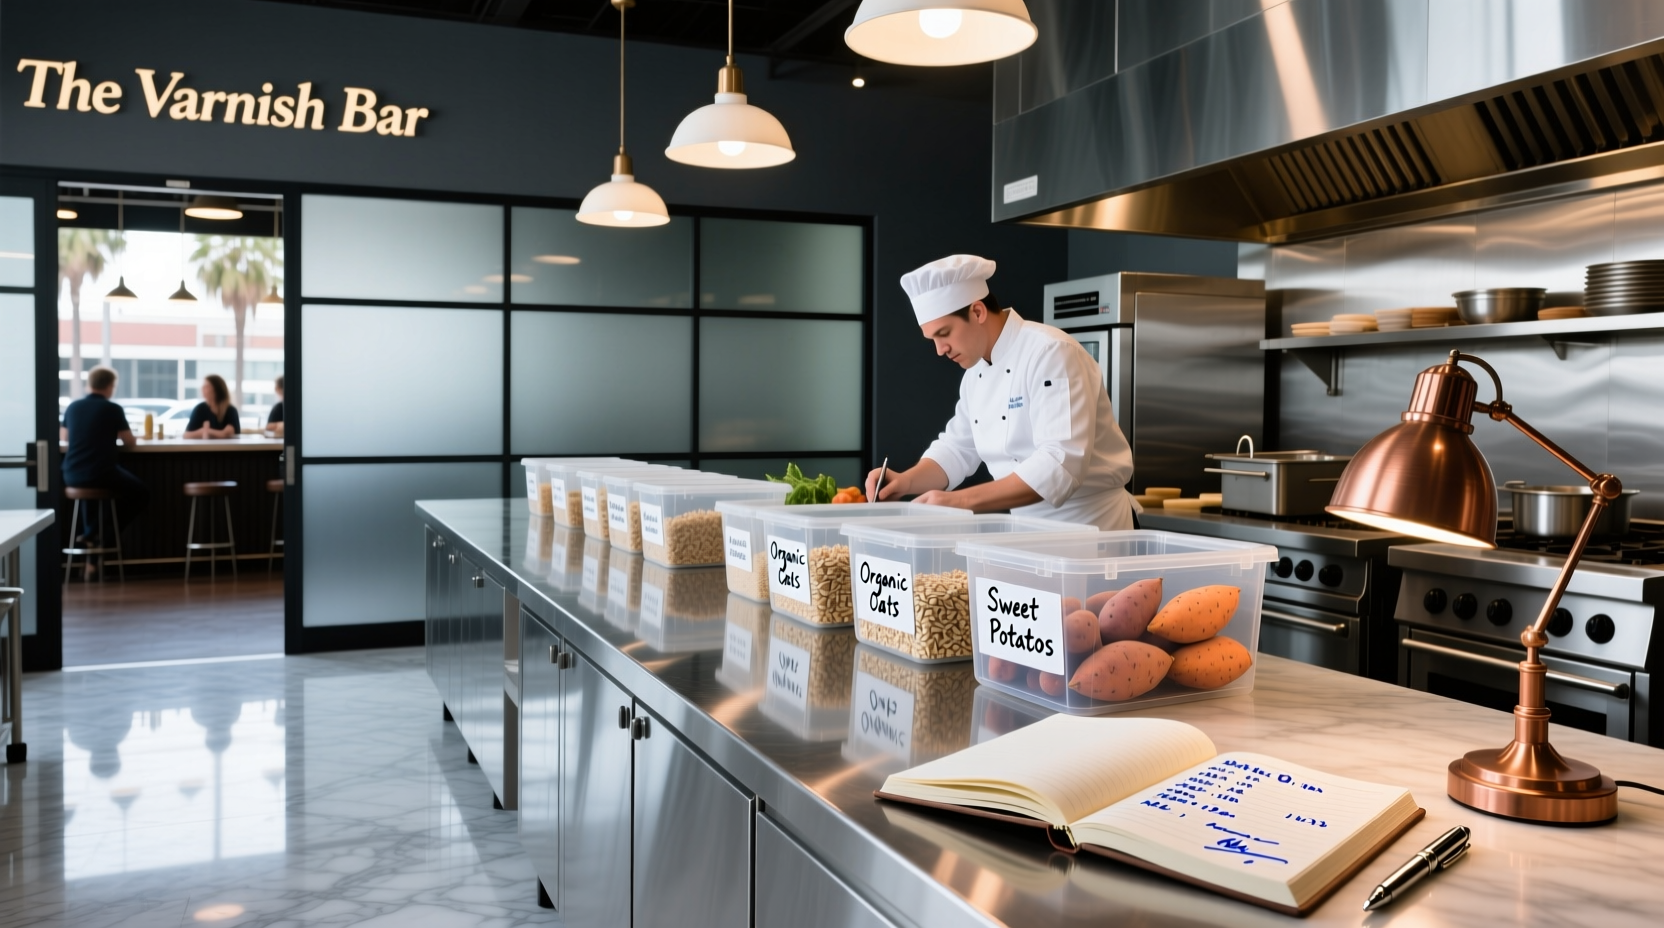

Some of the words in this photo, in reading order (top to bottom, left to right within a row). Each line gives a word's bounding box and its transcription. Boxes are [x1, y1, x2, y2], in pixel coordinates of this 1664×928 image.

[17, 58, 122, 114] The
[135, 68, 325, 131] Varnish
[338, 87, 430, 137] Bar
[860, 561, 909, 598] Organic
[870, 591, 900, 618] Oats
[987, 586, 1040, 621] Sweet
[989, 618, 1055, 657] Potatos
